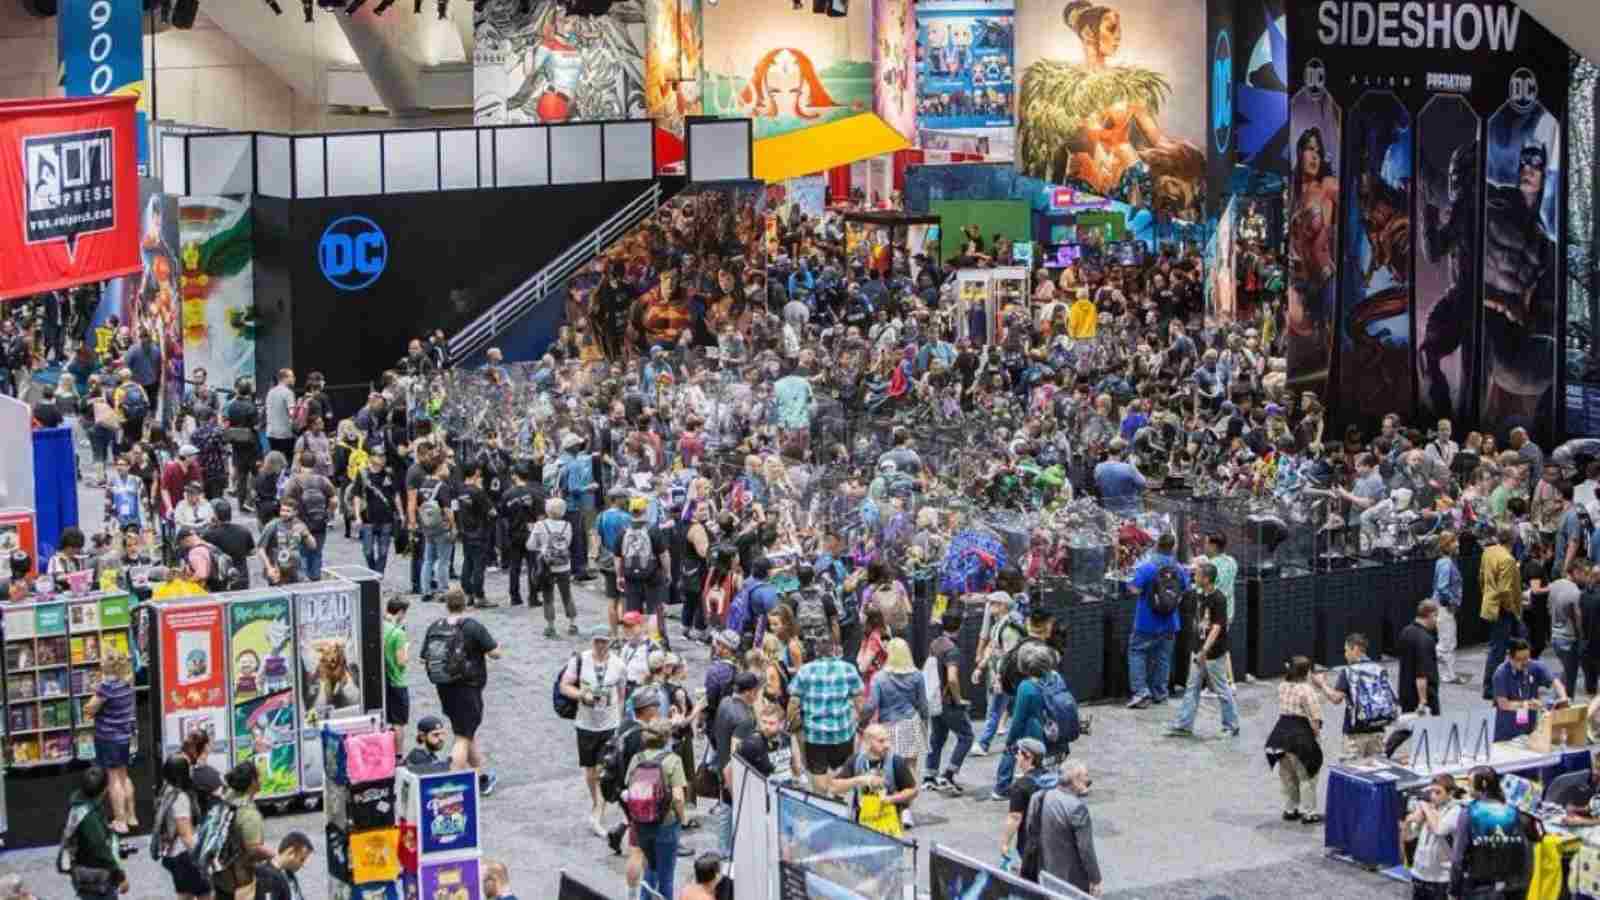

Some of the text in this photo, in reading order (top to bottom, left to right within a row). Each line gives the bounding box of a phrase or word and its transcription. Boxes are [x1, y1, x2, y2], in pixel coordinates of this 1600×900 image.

[1317, 1, 1520, 51] SIDESHOW
[90, 1, 112, 95] 900
[1304, 67, 1325, 88] DC
[1511, 78, 1536, 100] DC
[63, 185, 112, 206] PRESS
[320, 232, 384, 273] DC
